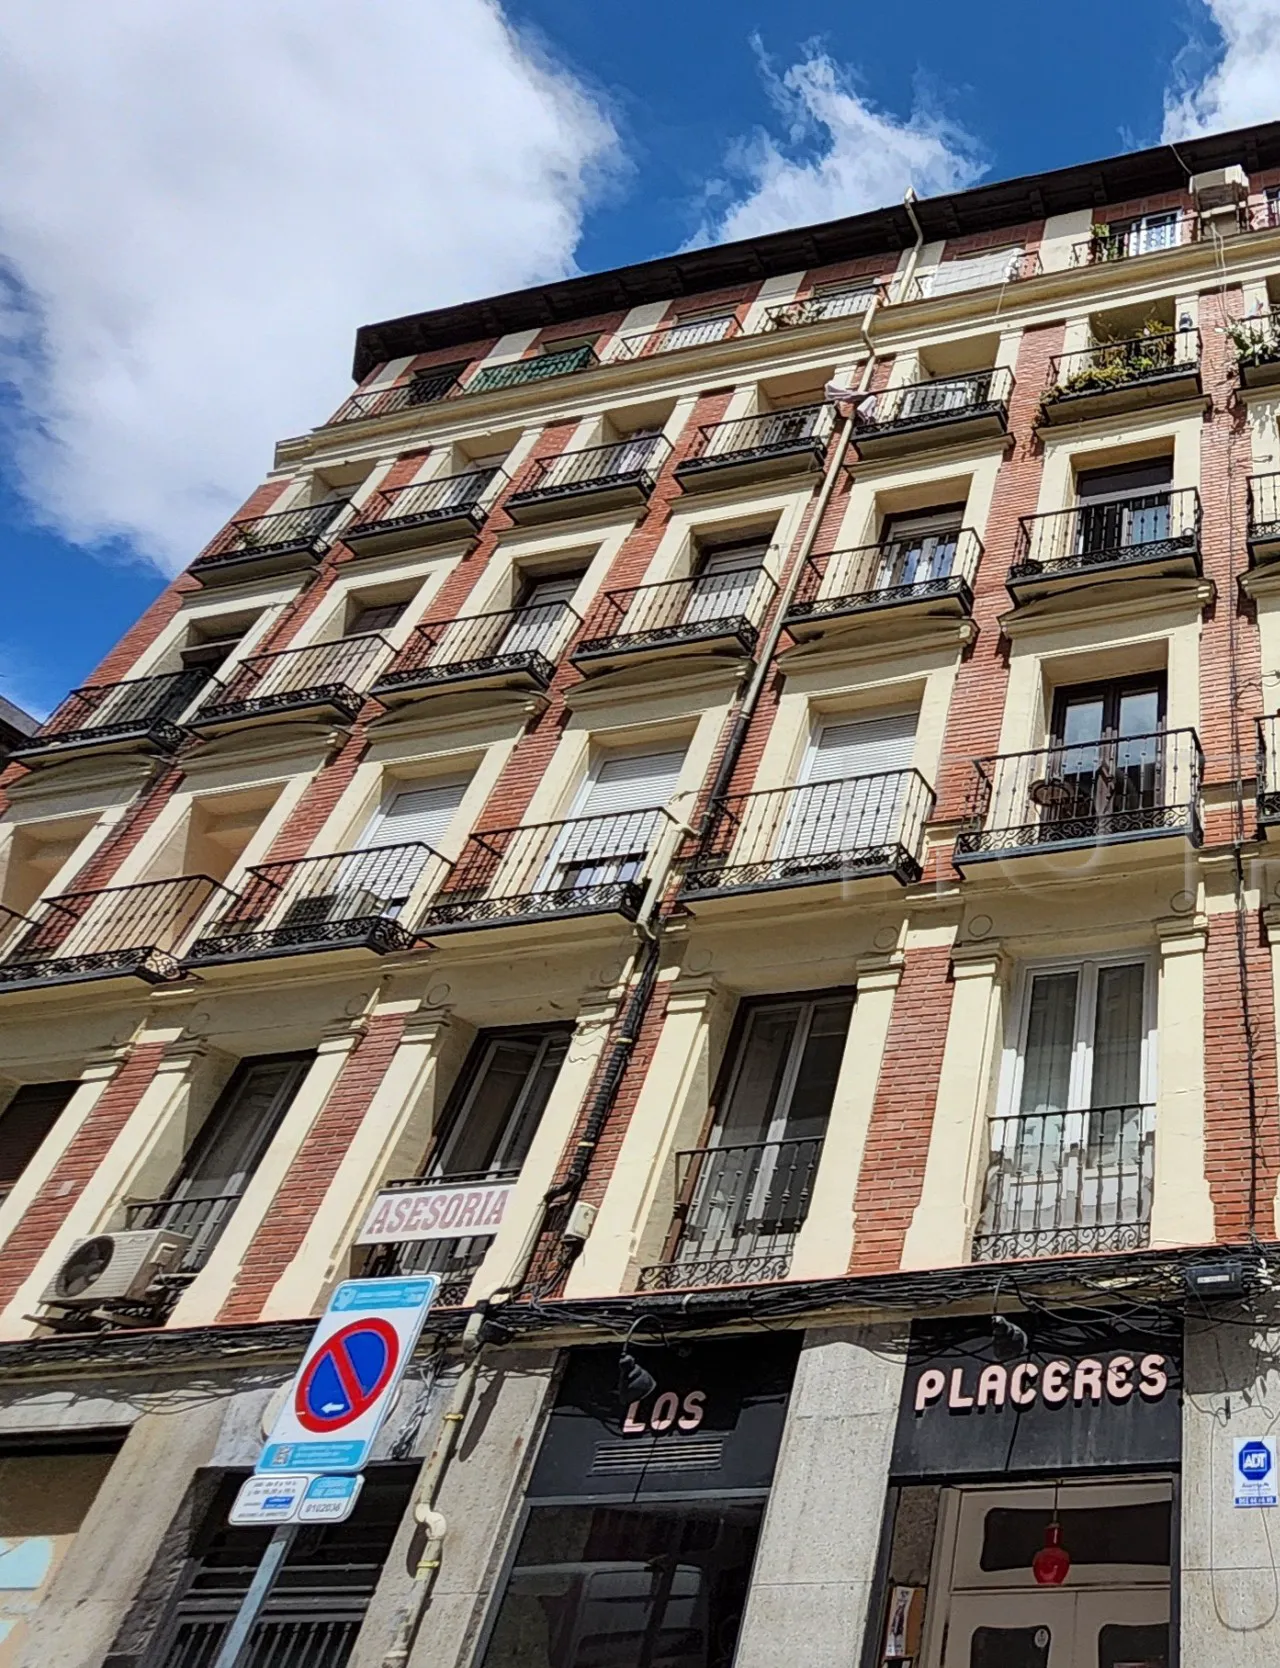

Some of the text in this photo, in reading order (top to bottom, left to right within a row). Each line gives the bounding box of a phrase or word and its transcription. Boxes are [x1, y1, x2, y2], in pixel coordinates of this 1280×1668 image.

[366, 1189, 509, 1235] ASESORIA
[623, 1390, 707, 1433] LOS
[914, 1354, 1168, 1411] PLACERES
[1244, 1453, 1267, 1468] ADT
